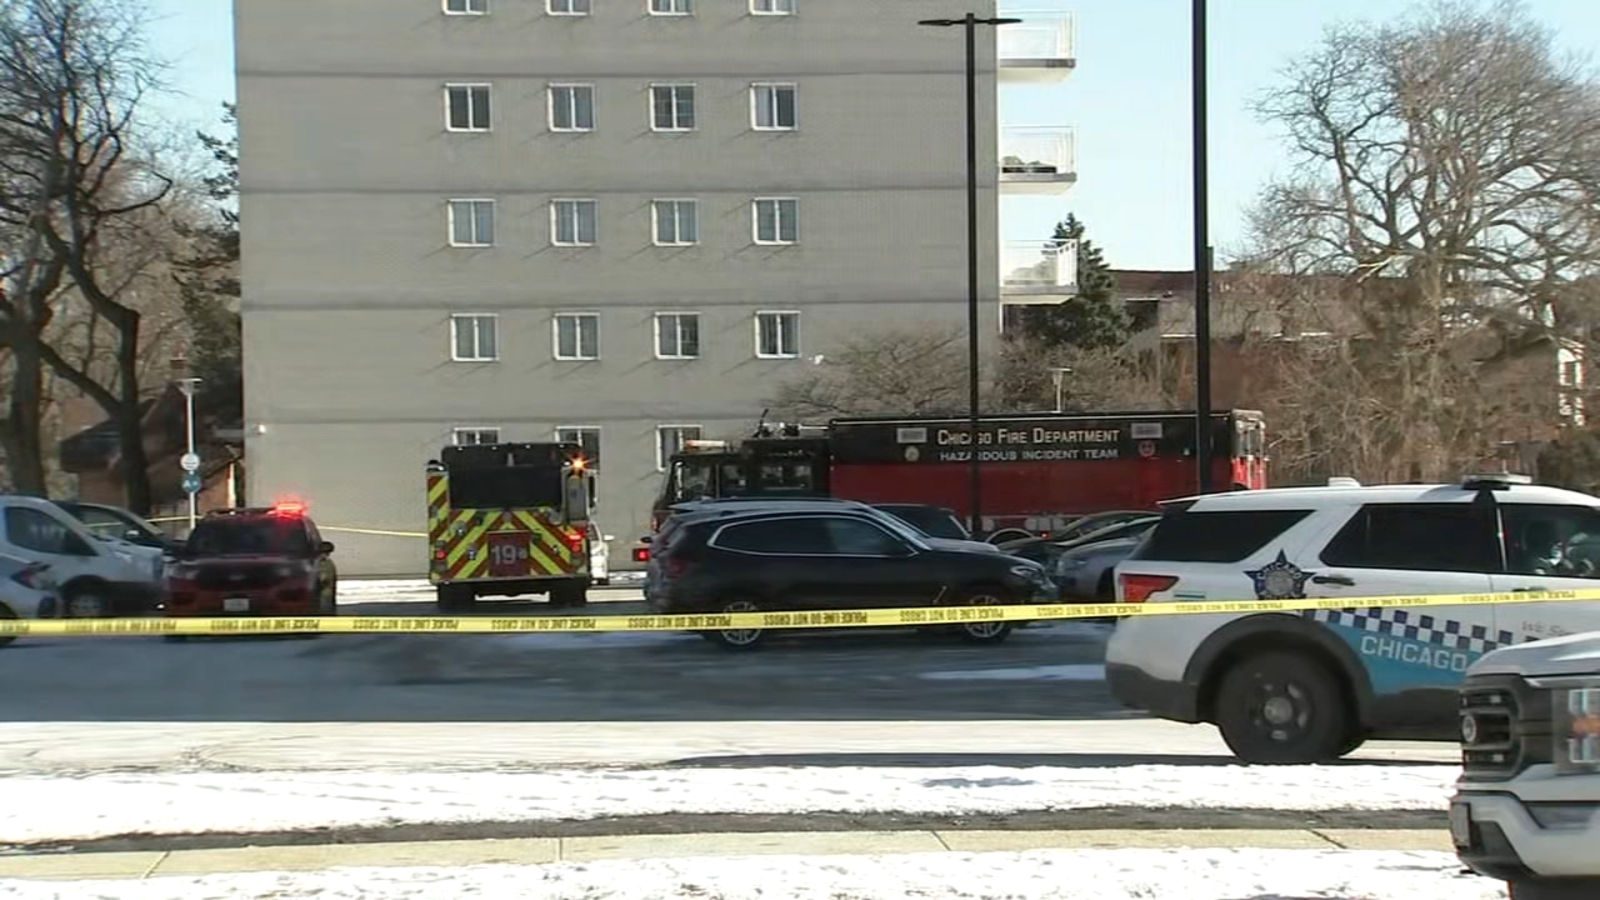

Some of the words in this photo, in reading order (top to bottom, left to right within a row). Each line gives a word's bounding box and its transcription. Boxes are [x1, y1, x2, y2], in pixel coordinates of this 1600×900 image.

[937, 429, 991, 445] CHICGO
[997, 428, 1027, 443] FIRE
[1032, 427, 1120, 443] DEPARTMENT
[1022, 449, 1079, 460] INCIDENT
[1085, 449, 1118, 460] TEAM
[810, 613, 821, 625] DO
[823, 613, 840, 624] LINE
[842, 612, 868, 623] POLICE
[900, 611, 927, 622] CROSS
[929, 610, 944, 621] NOT
[947, 610, 957, 620] DO
[959, 609, 976, 619] LINE
[978, 608, 1004, 619] POLICE
[763, 614, 791, 626] CROSS
[793, 614, 808, 625] NOT
[1360, 636, 1467, 672] CHICAGO
